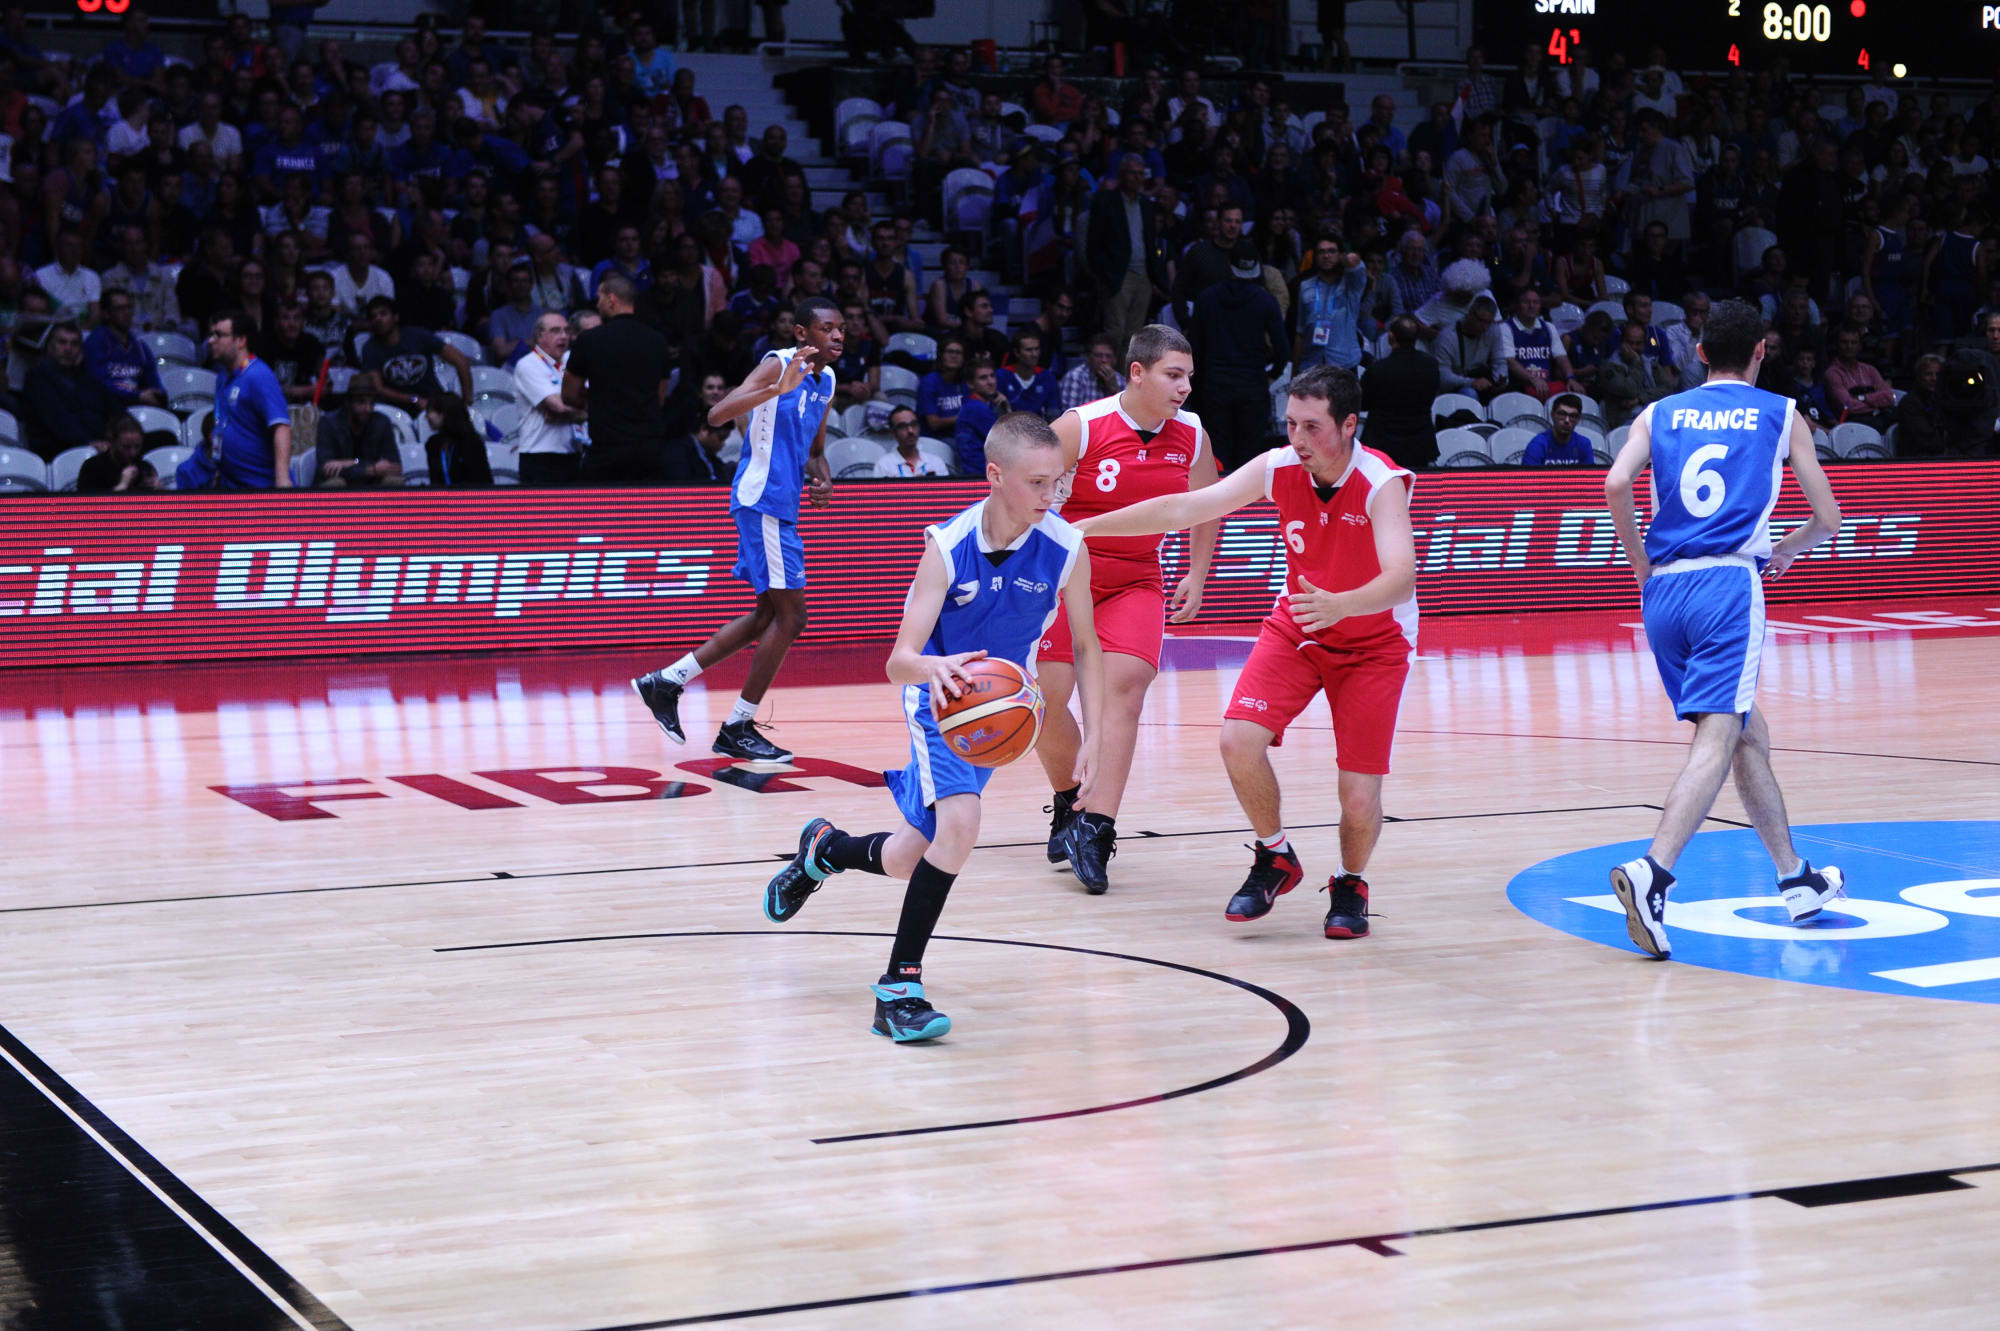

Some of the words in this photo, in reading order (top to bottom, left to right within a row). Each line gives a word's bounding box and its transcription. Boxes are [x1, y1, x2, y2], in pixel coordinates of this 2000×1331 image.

[1535, 0, 1595, 14] SPAIN
[1728, 0, 1741, 16] 2
[1763, 2, 1831, 42] 8:00
[1728, 43, 1740, 66] 4
[1857, 48, 1869, 70] 4
[798, 389, 807, 419] 4
[1672, 407, 1759, 430] FRANCE
[1096, 458, 1121, 492] 8
[1680, 443, 1729, 518] 6
[1285, 520, 1305, 554] 6
[213, 536, 713, 622] Olympics
[207, 757, 888, 821] FIBA
